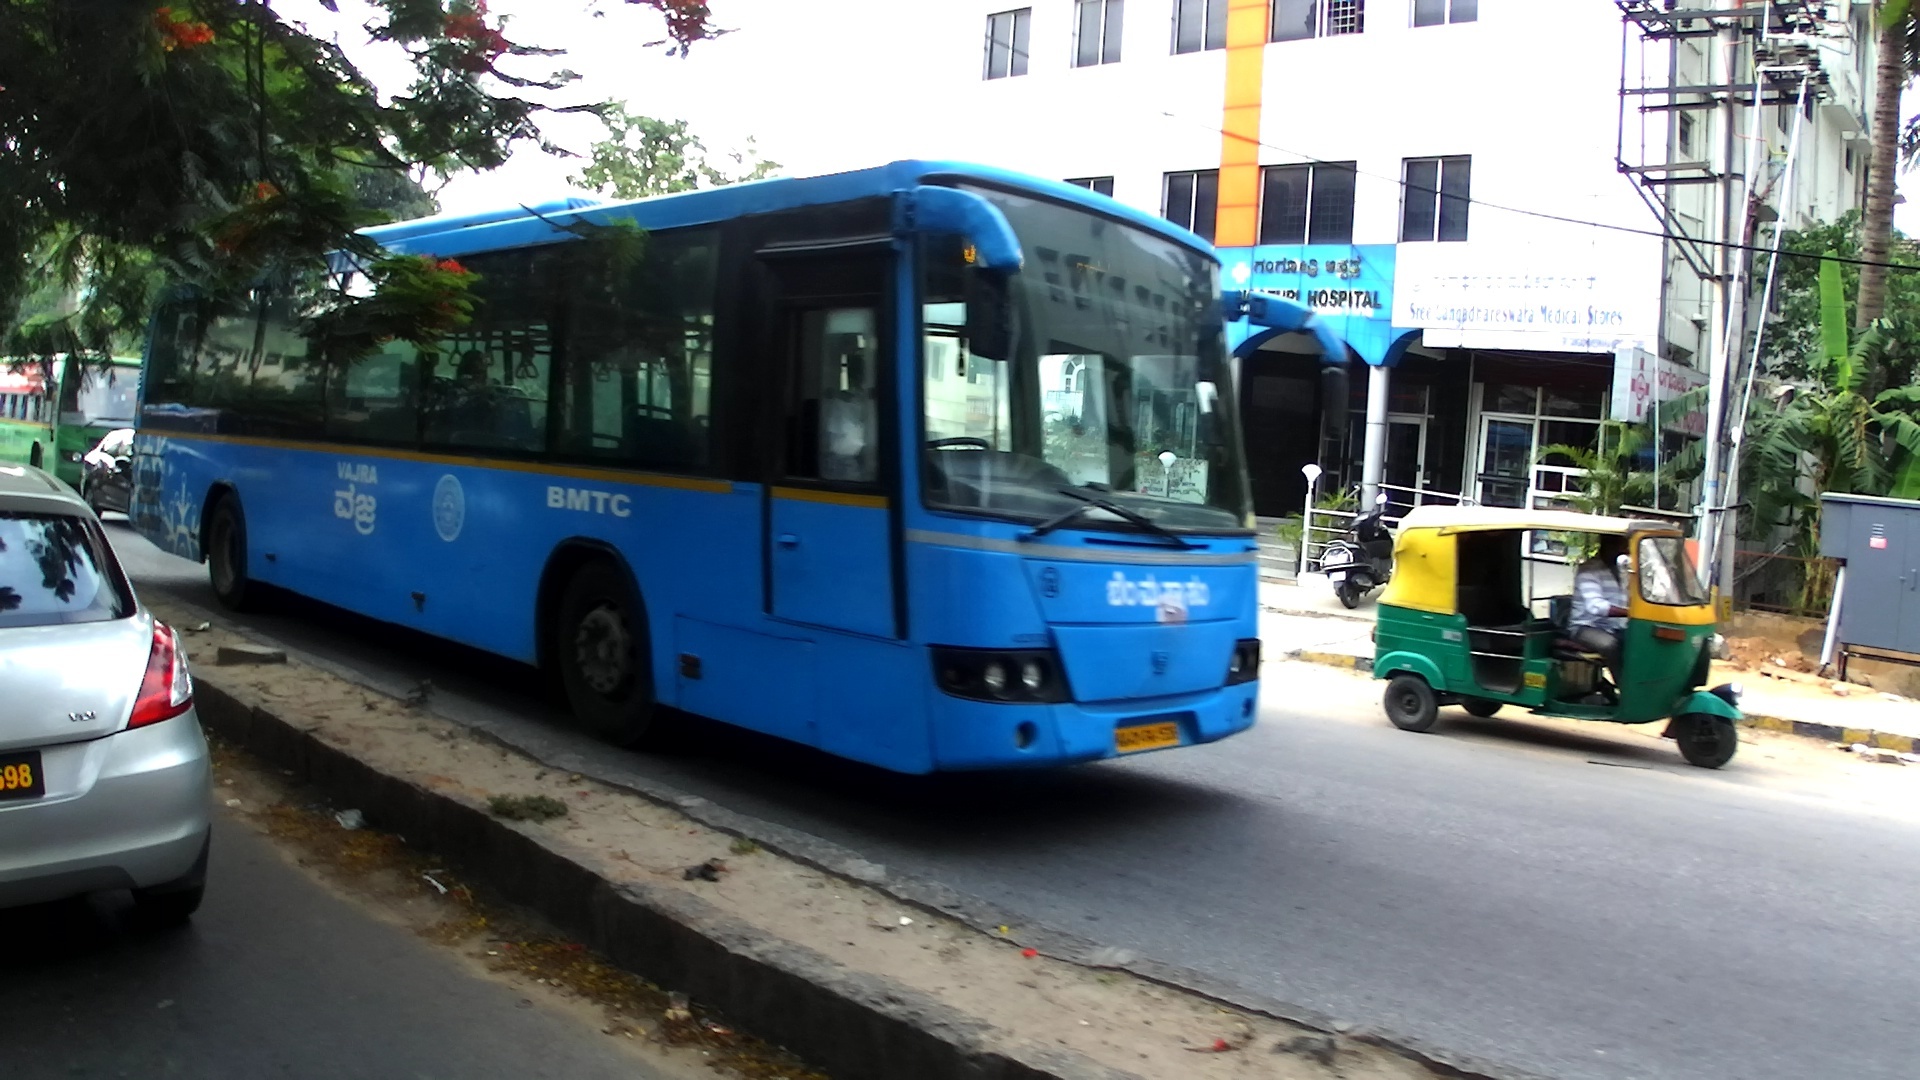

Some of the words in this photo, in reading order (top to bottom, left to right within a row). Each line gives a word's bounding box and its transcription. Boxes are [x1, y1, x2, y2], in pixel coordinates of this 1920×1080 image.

[1307, 289, 1382, 309] HOSPITAL
[1587, 304, 1623, 326] Stores
[336, 461, 378, 485] VAJRA
[547, 486, 632, 518] BMTC
